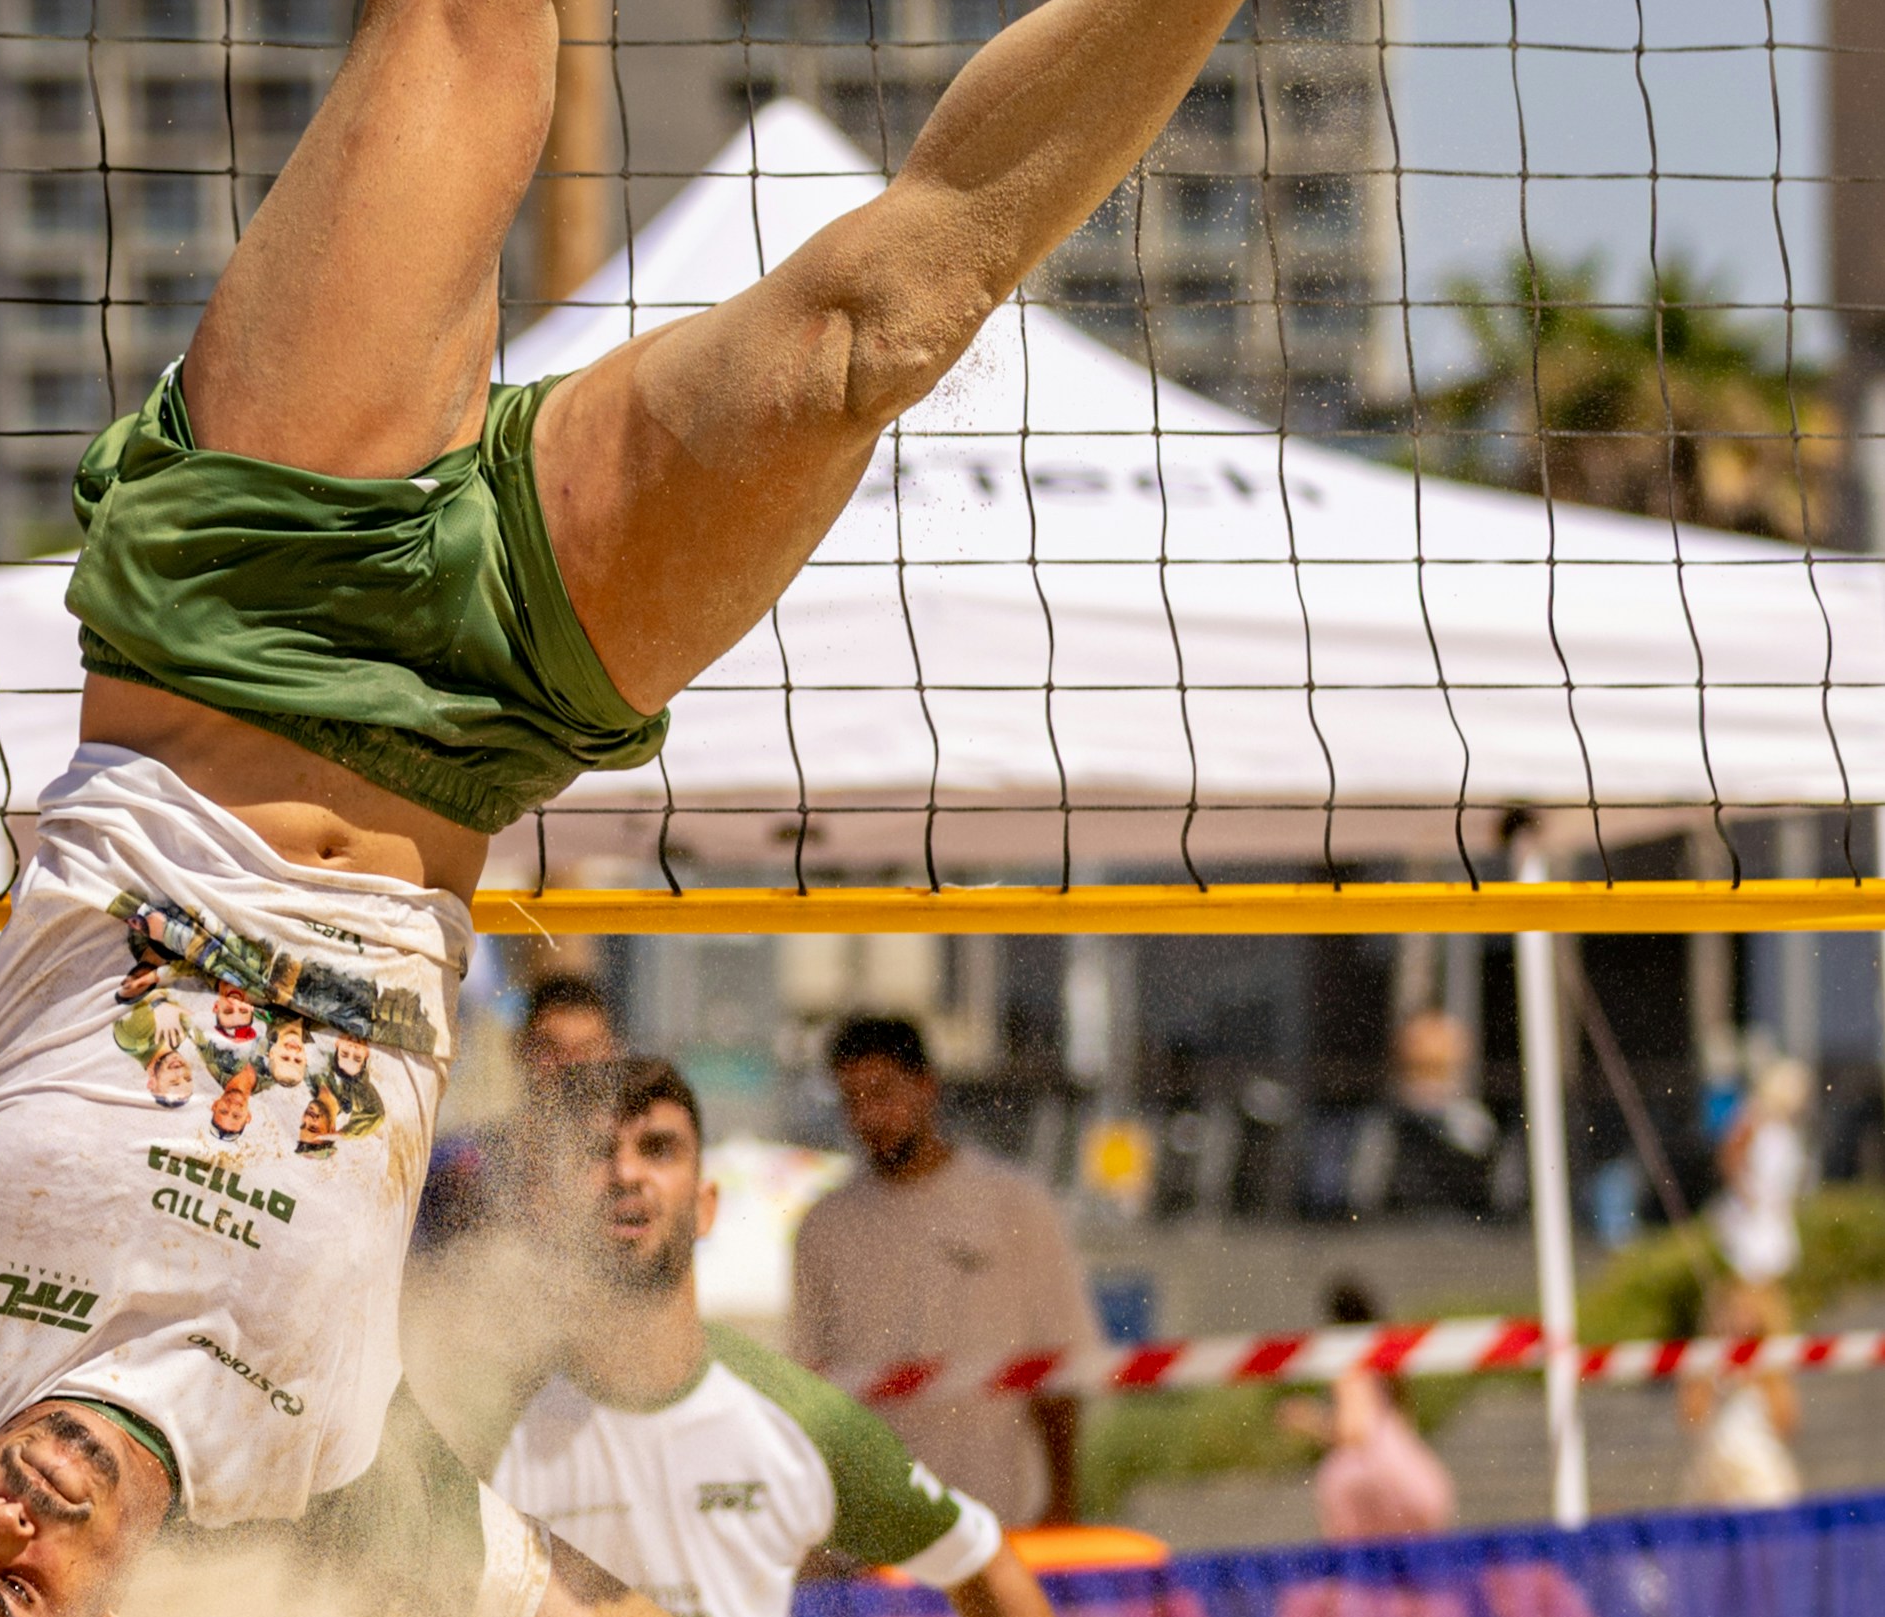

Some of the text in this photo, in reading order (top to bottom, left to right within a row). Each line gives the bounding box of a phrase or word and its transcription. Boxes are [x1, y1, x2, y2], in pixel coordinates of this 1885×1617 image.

[148, 1145, 296, 1224] גיבורים
[9, 1261, 90, 1286] ISRAEL
[187, 1333, 275, 1393] STORMO
